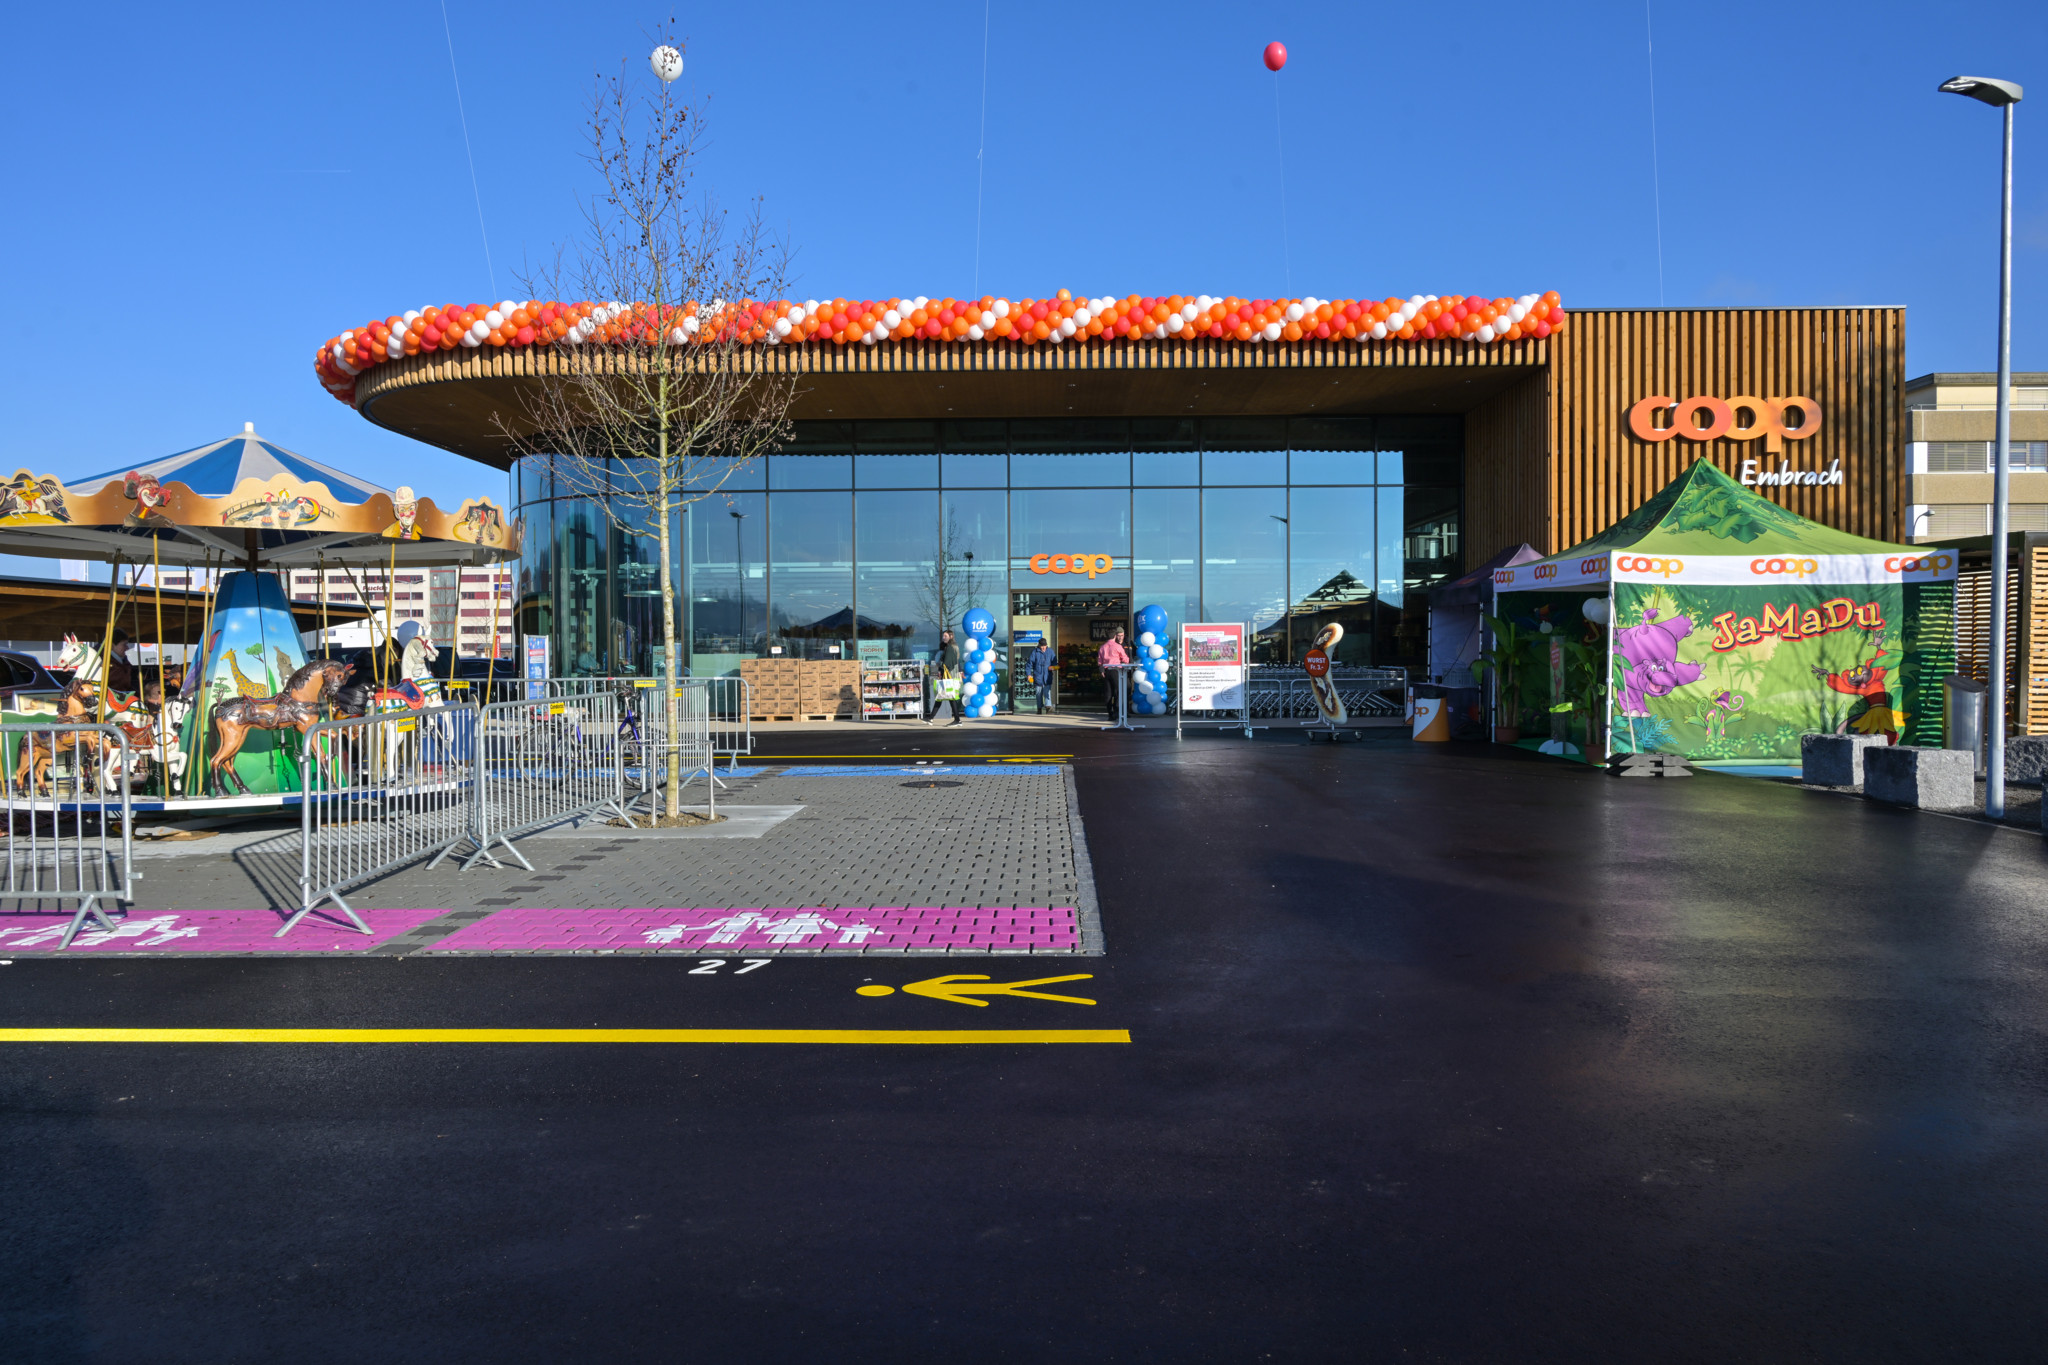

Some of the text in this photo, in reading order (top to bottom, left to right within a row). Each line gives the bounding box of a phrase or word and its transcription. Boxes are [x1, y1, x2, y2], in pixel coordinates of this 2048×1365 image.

[1629, 395, 1823, 453] coop
[1740, 458, 1843, 486] Embrach
[1029, 553, 1113, 580] coop
[1534, 563, 1558, 581] coop
[1581, 556, 1608, 578] coop
[1616, 555, 1684, 578] coop
[1750, 558, 1818, 578] coop
[1884, 554, 1953, 577] coop
[1495, 570, 1515, 587] coop
[971, 620, 988, 630] 10x
[1713, 598, 1884, 651] JaMaDu
[688, 959, 772, 974] 27
